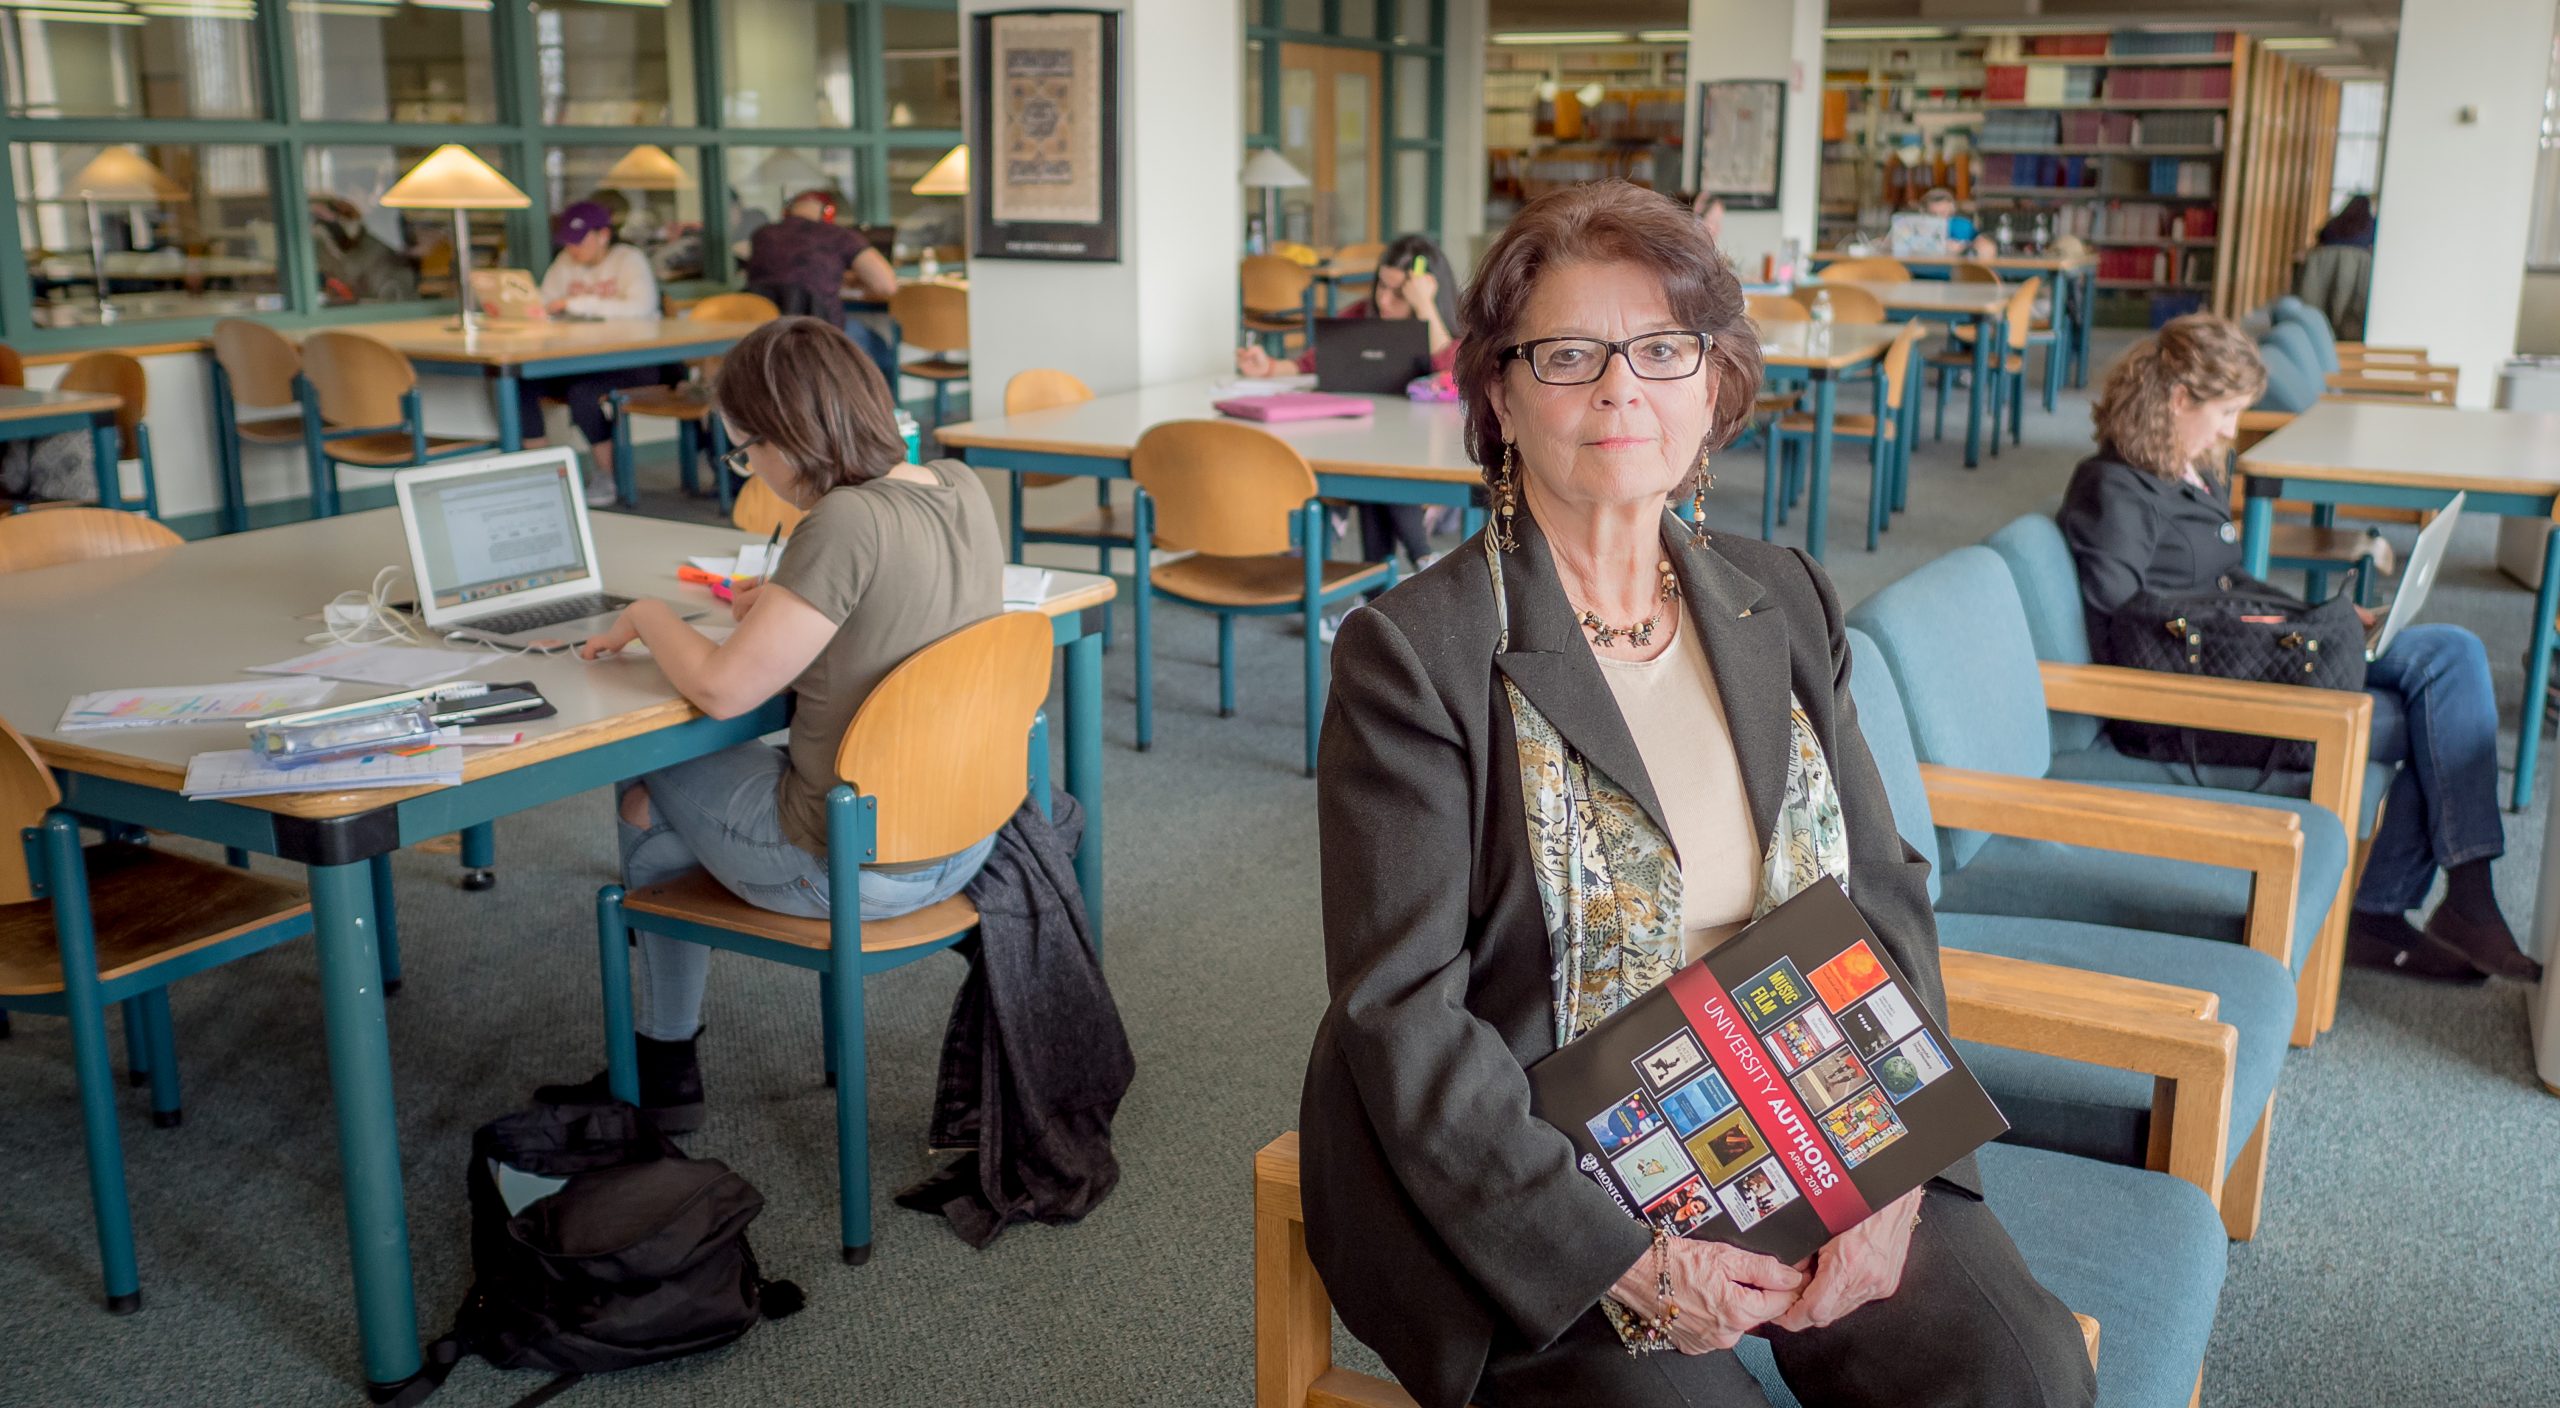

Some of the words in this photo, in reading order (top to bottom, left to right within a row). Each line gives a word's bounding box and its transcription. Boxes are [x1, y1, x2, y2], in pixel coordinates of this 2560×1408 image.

[1748, 984, 1778, 1016] FILM
[1767, 969, 1799, 1006] MUSIC
[1678, 1042, 1694, 1061] LATIN
[1700, 995, 1779, 1098] UNIVERSITY
[1766, 1092, 1840, 1190] AUTHORS
[1844, 1143, 1867, 1162] BEN
[1863, 1121, 1902, 1149] WILSON
[1786, 1148, 1809, 1176] APRIL
[1803, 1173, 1824, 1197] 2018
[1662, 1212, 1673, 1225] The
